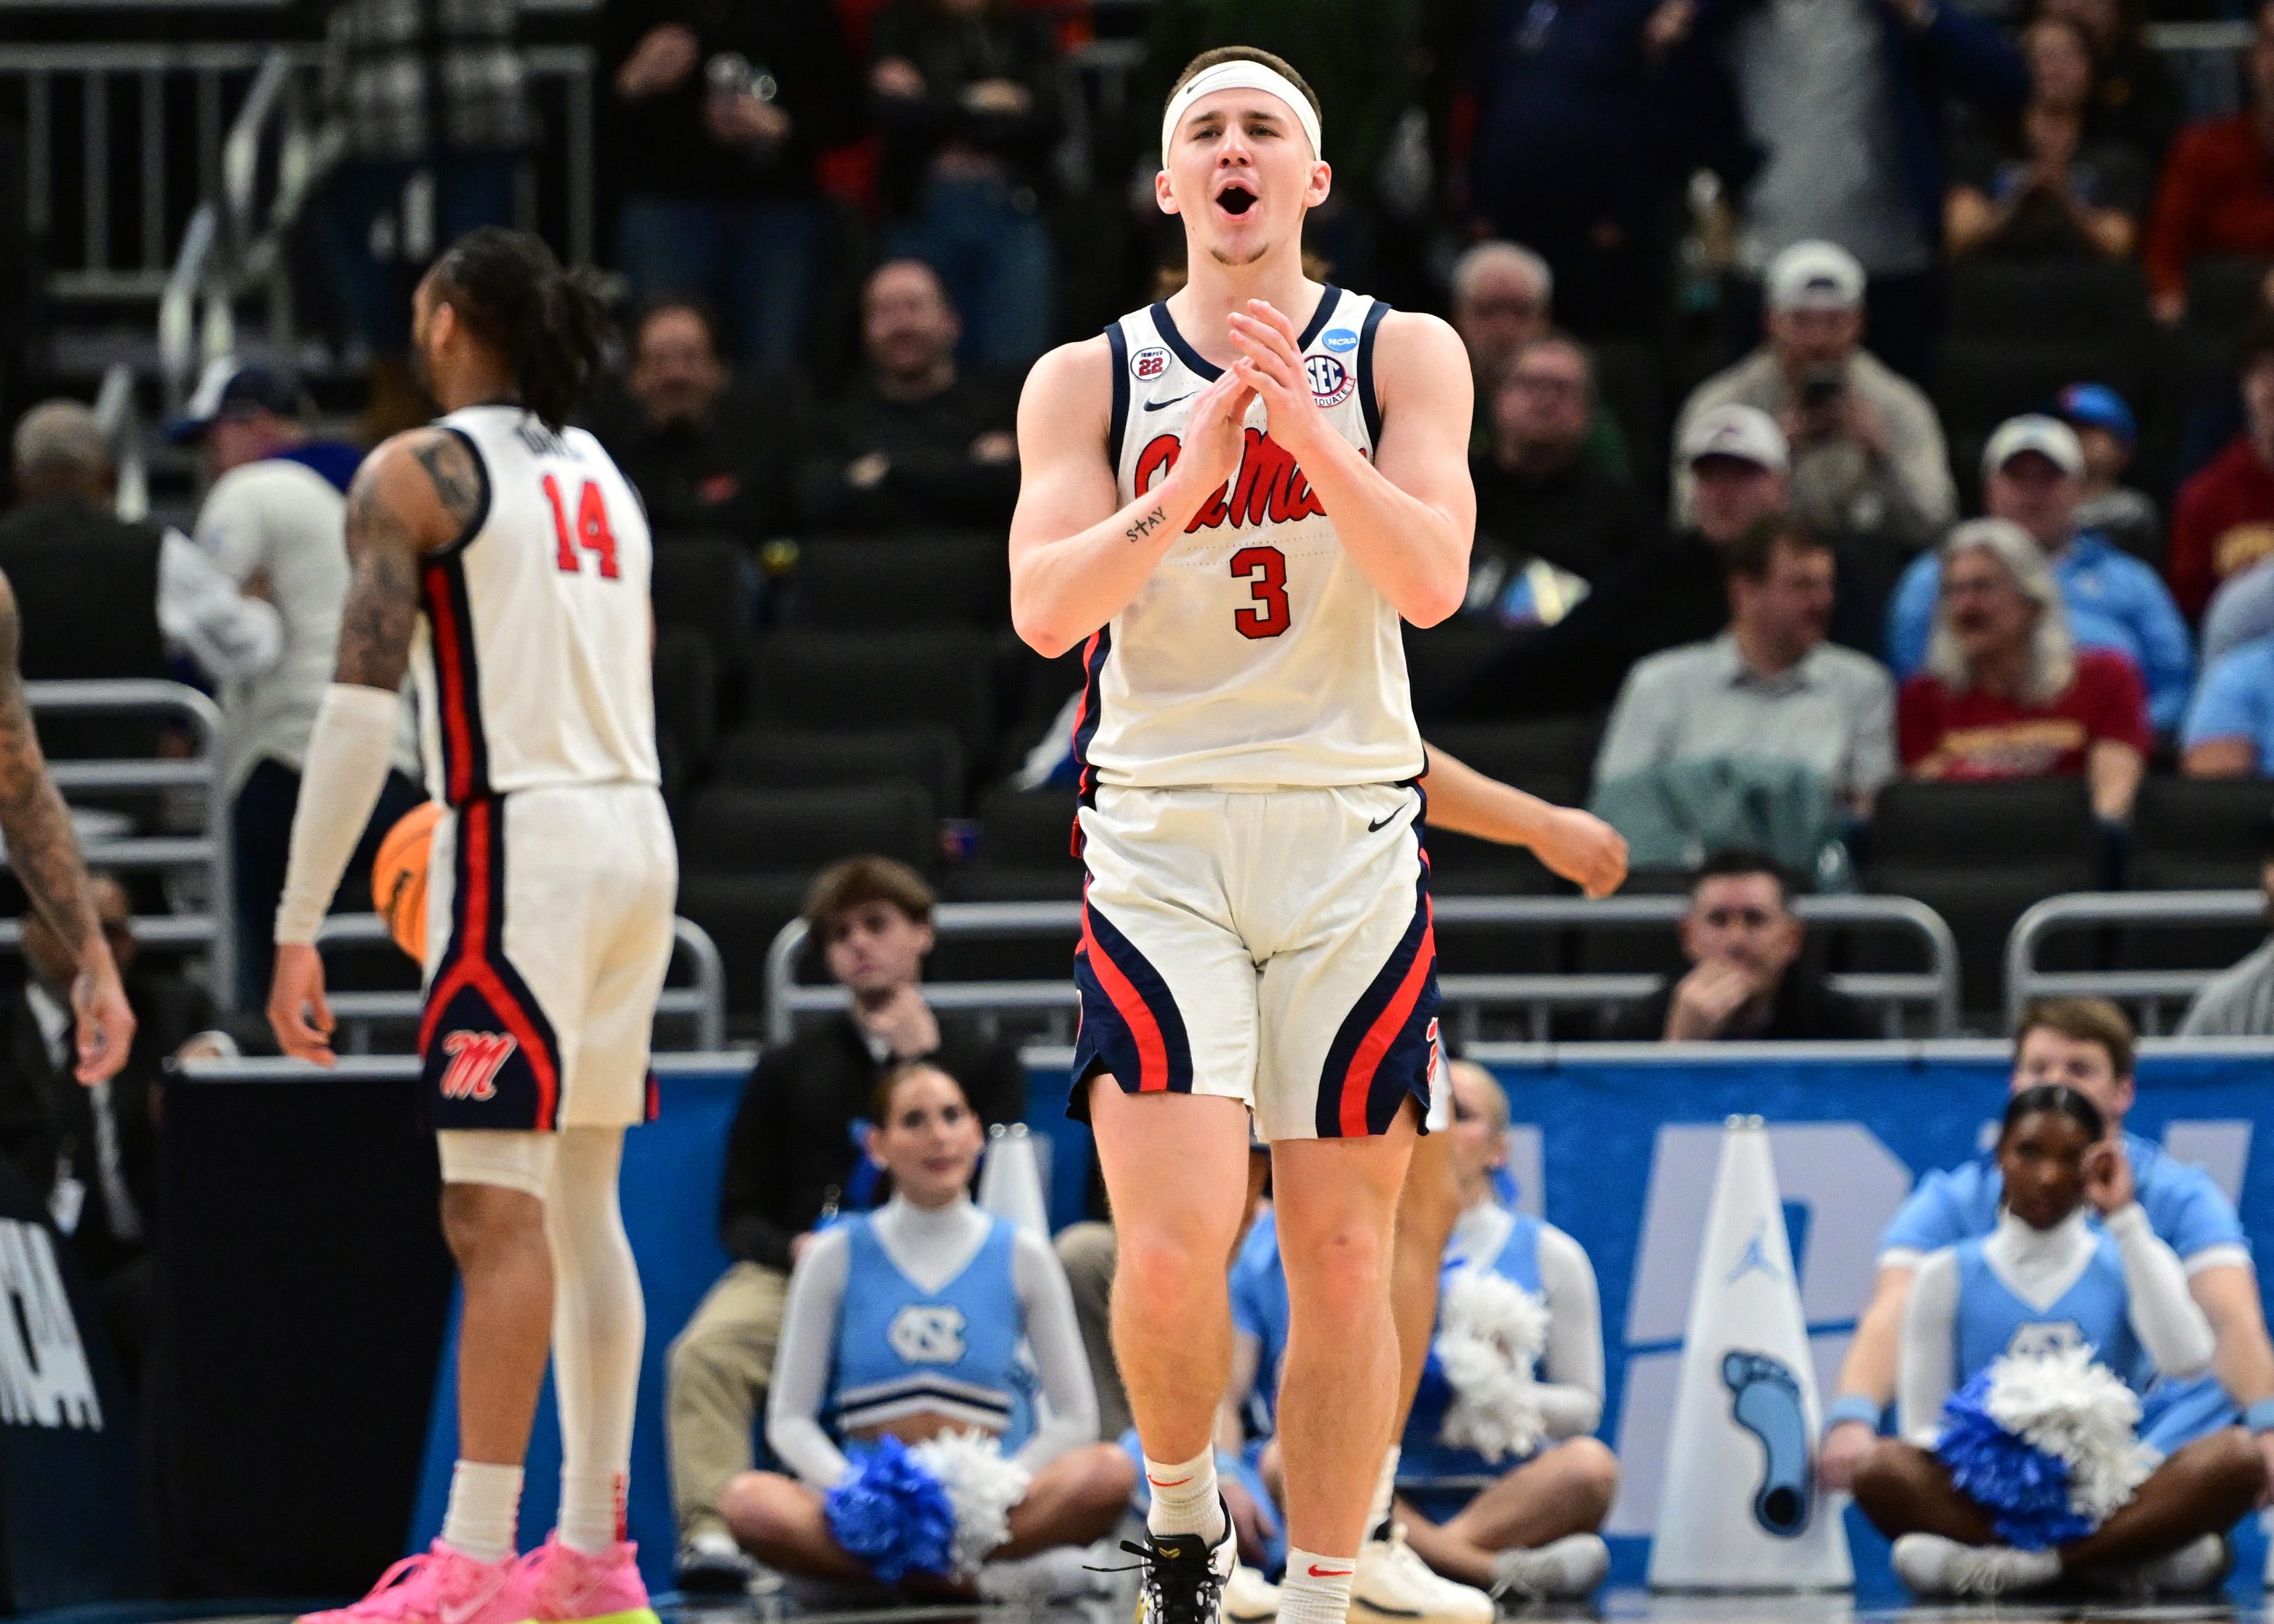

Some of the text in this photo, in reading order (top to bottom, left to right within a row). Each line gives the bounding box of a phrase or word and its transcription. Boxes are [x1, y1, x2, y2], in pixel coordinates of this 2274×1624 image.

[1328, 337, 1357, 345] NCAA
[1139, 357, 1163, 376] 22
[1305, 357, 1343, 394] SEC
[1314, 387, 1350, 406] DUATE
[1134, 433, 1228, 534] Oe
[542, 473, 619, 580] 14
[1126, 506, 1166, 543] STAY
[1229, 546, 1291, 640] 3
